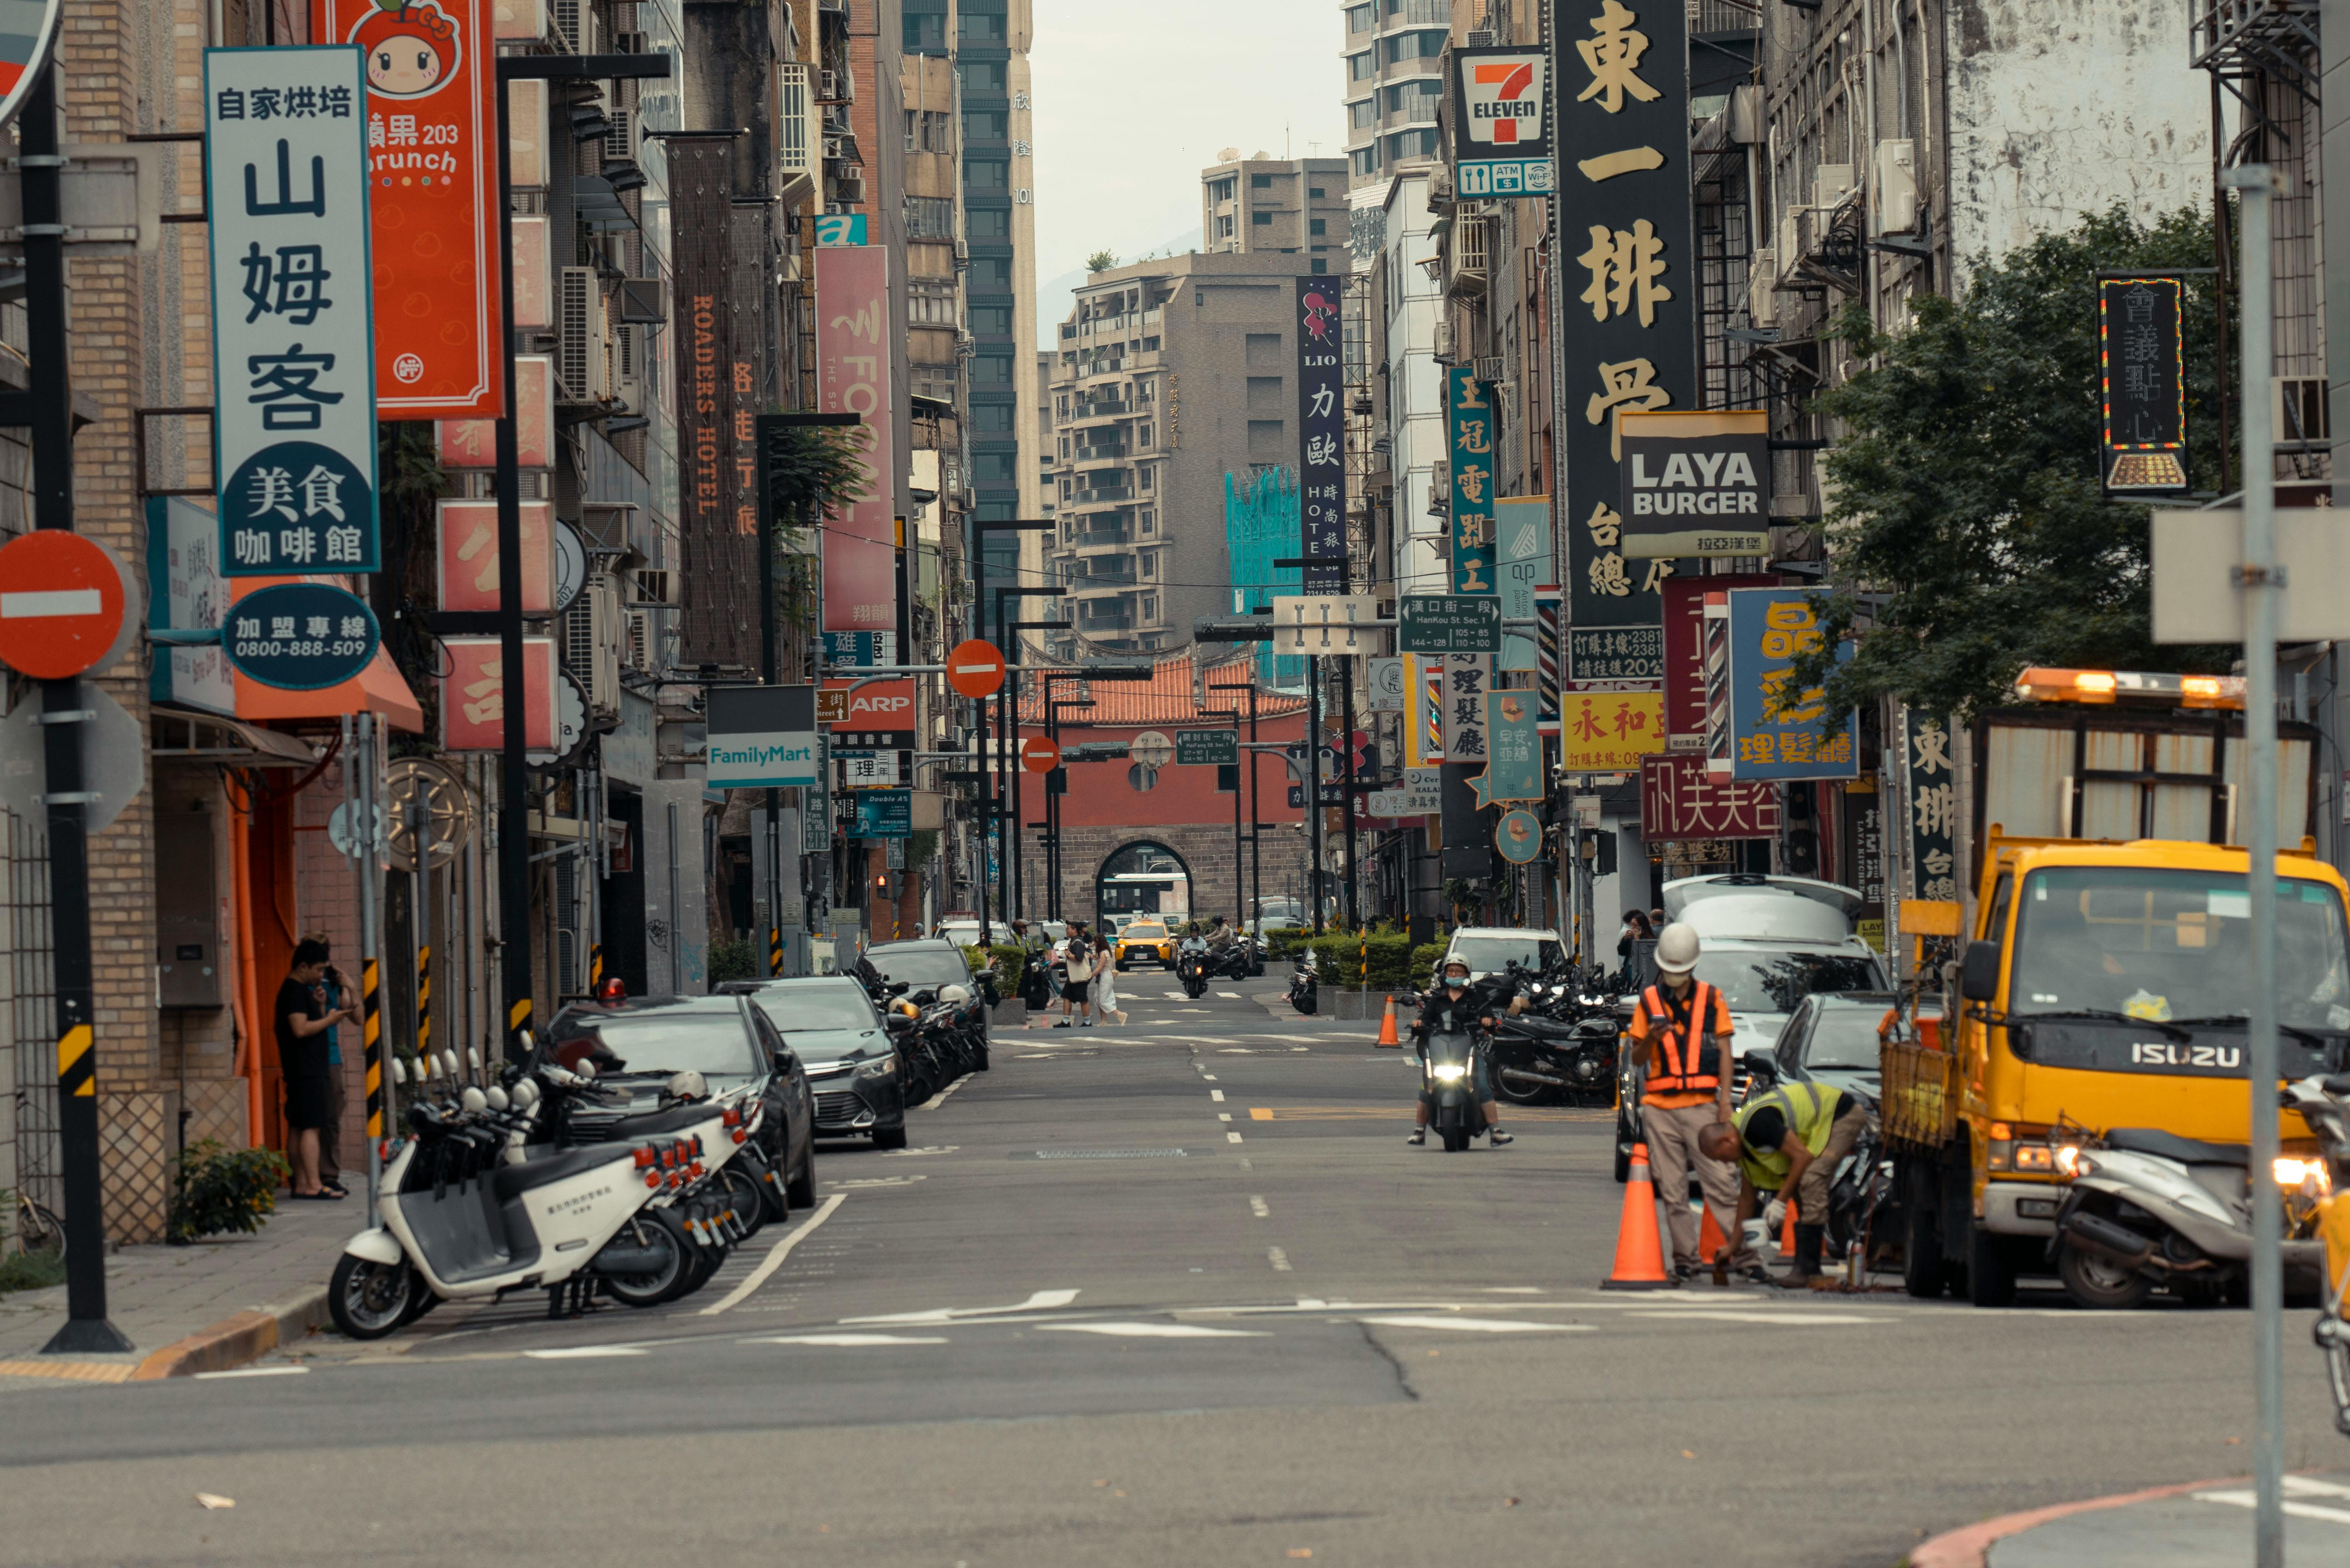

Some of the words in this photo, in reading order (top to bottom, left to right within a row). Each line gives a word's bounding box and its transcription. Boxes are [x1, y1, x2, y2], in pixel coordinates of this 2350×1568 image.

[218, 85, 351, 121] 自家烘培
[1475, 62, 1533, 143] 7
[422, 124, 459, 145] 203
[1496, 166, 1519, 176] ATM
[240, 138, 345, 431] 山姆客
[693, 294, 716, 414] ROADERS
[1303, 355, 1336, 367] LIO
[1307, 383, 1340, 466] 力歐
[697, 427, 719, 516] HOTEL
[1632, 453, 1758, 487] LAYA
[247, 464, 346, 523] 美食
[1633, 492, 1758, 515] BURGER
[235, 524, 362, 565] 咖啡館
[1698, 537, 1761, 550] 拉亞漢堡
[1411, 600, 1491, 613] 漢口街一段
[236, 616, 367, 638] 加盟專線
[236, 641, 367, 657] 0800-888-509
[710, 745, 811, 767] FamilyMart
[2131, 1042, 2240, 1069] ISUZU
